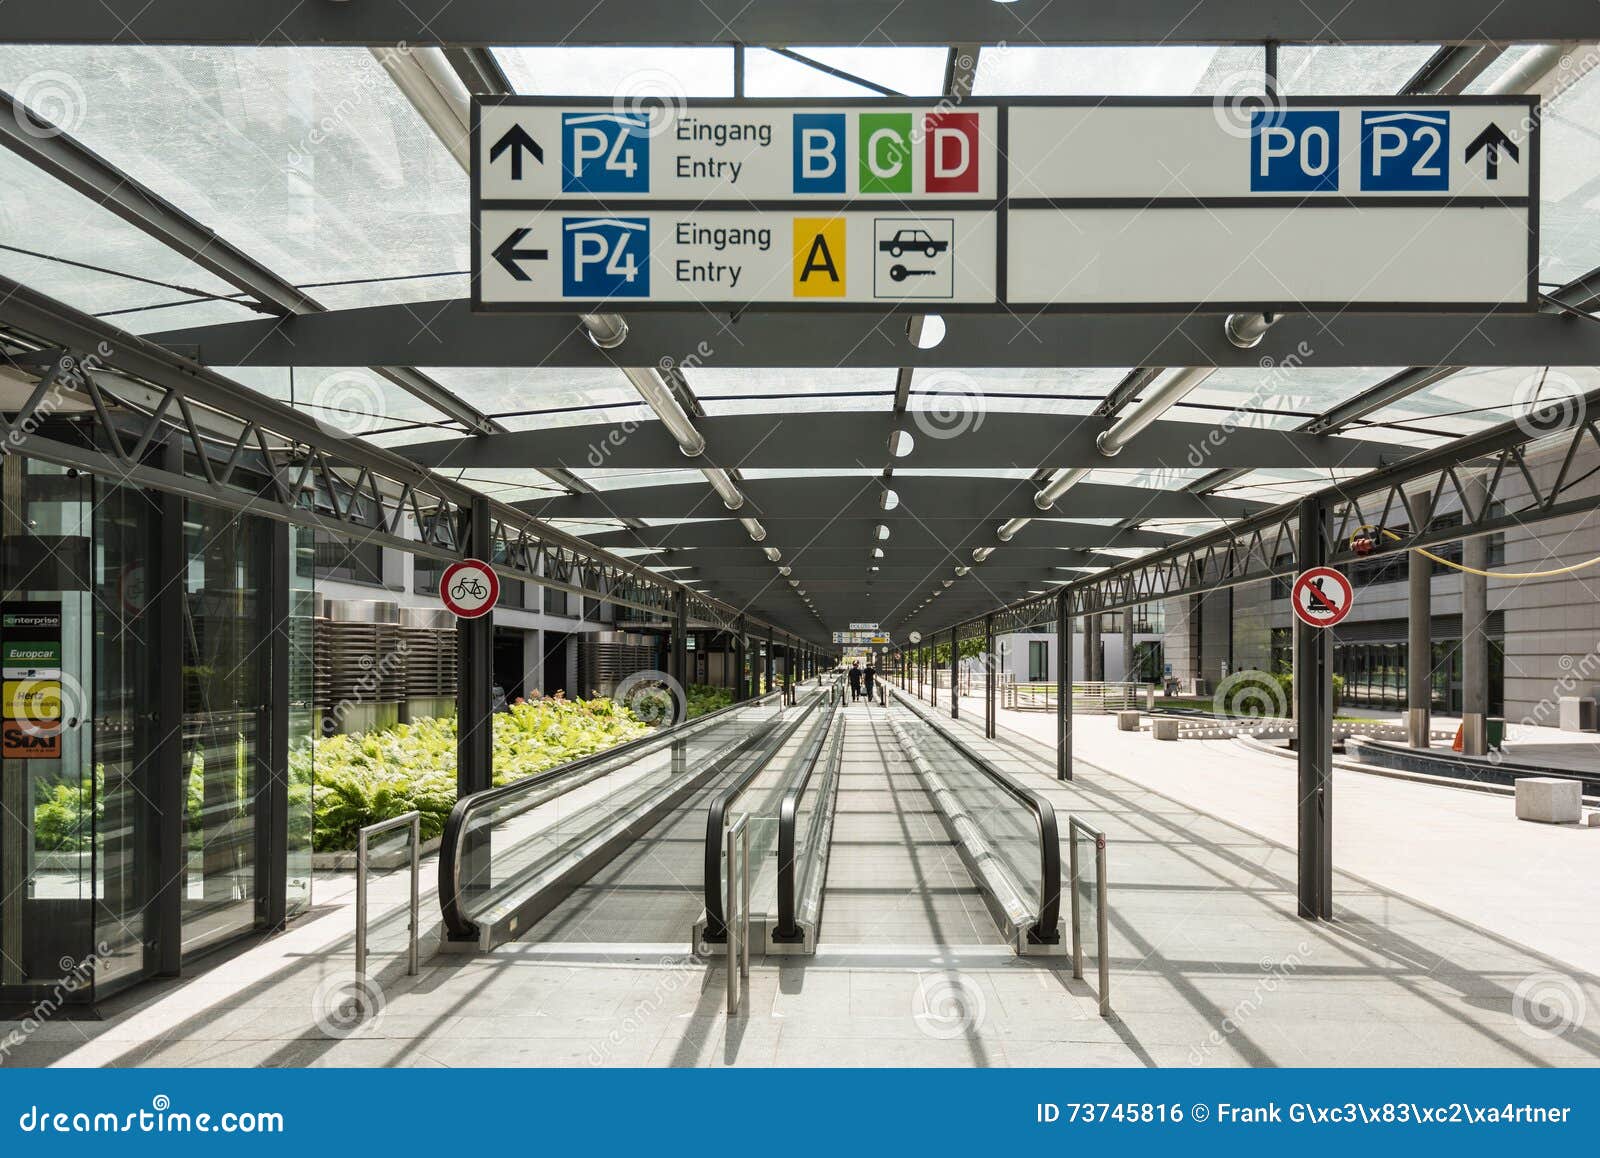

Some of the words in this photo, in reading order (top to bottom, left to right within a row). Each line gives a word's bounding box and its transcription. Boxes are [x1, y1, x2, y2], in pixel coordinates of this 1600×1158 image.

[676, 118, 772, 147] Eingang
[574, 128, 638, 178] P4
[803, 128, 837, 178] B
[868, 128, 904, 178] C
[934, 128, 970, 178] D
[1260, 127, 1330, 177] P0
[1372, 126, 1442, 176] P2
[676, 155, 742, 184] Entry
[676, 223, 771, 251] Eingang
[574, 233, 638, 282] P4
[799, 233, 840, 282] A
[676, 260, 742, 288] Entry
[7, 616, 59, 627] enterprise
[10, 649, 54, 660] Europcar
[17, 690, 44, 701] Hertz
